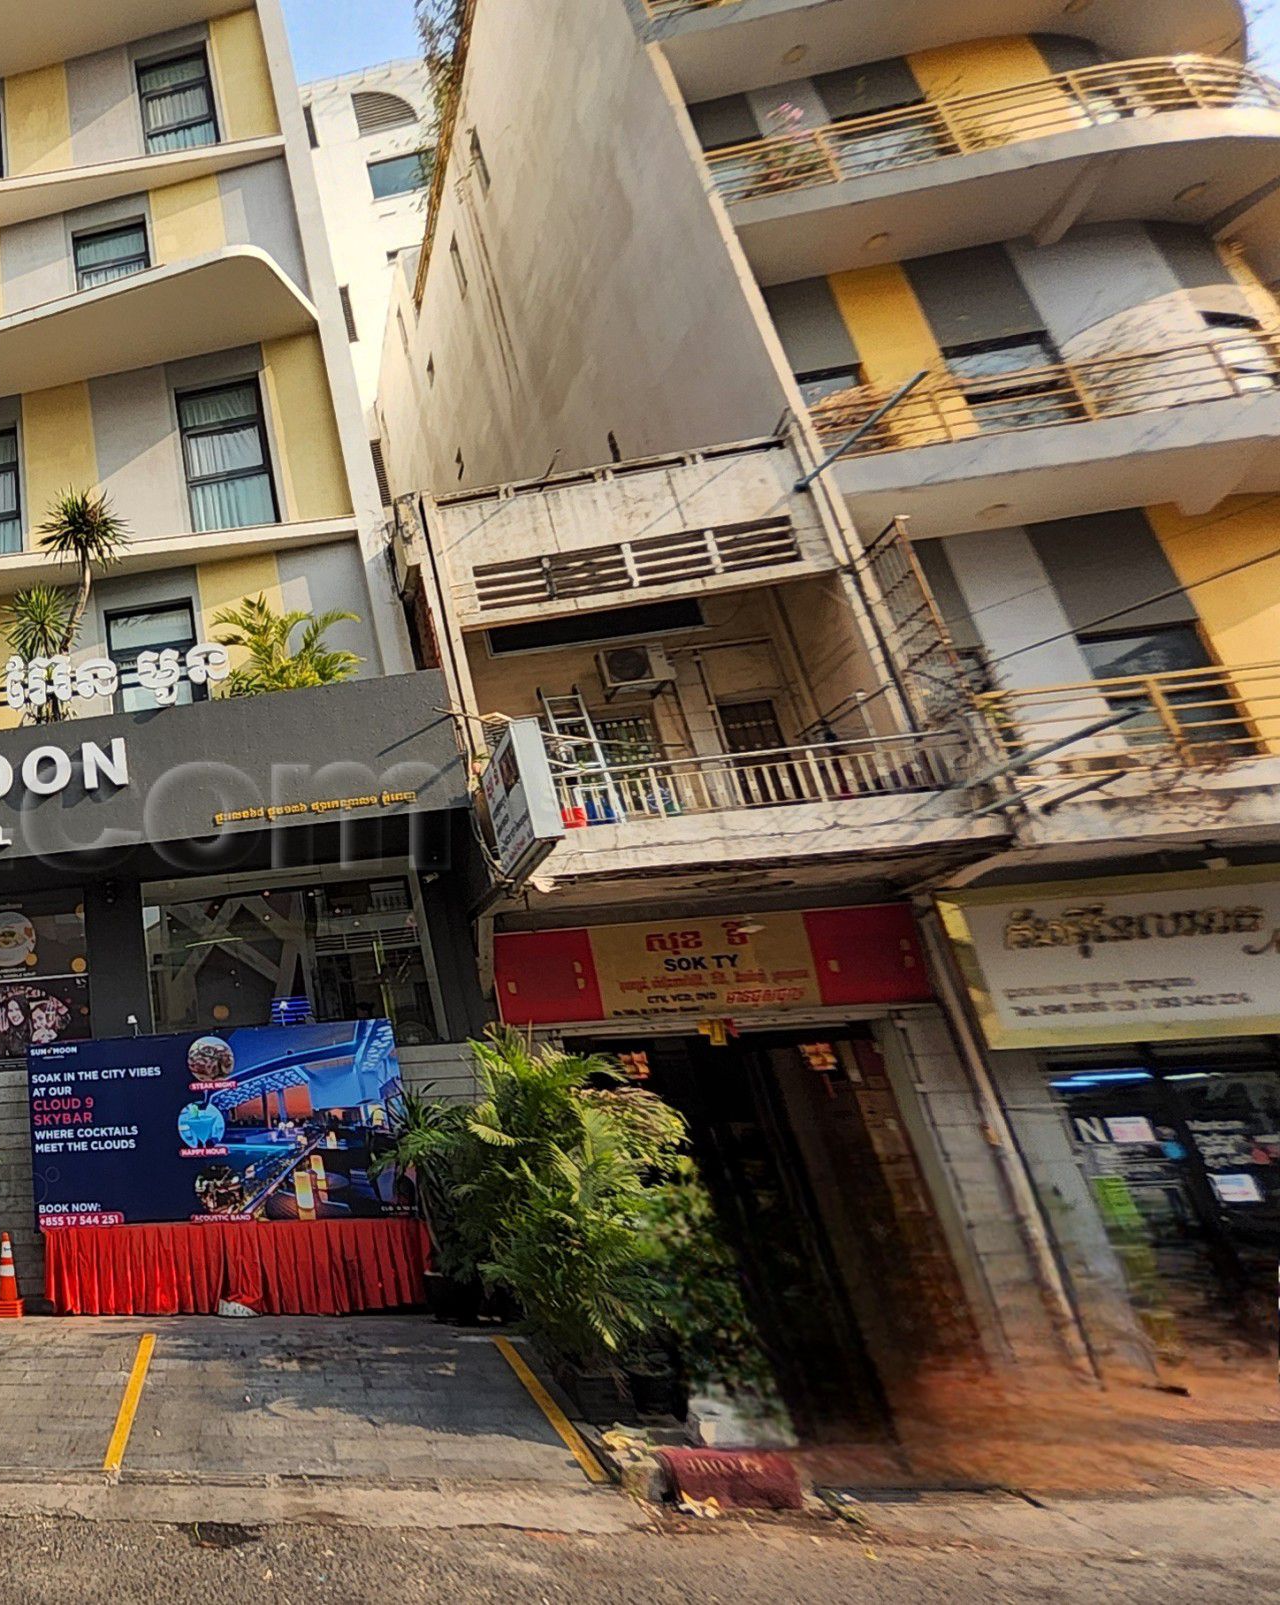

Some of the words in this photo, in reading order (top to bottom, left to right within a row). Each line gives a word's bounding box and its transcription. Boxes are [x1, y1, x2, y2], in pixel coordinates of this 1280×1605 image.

[663, 956, 708, 972] SOK
[711, 953, 739, 969] TY
[52, 1046, 78, 1055] MOON
[31, 1072, 62, 1084] SOAK
[63, 1071, 76, 1082] IN
[77, 1070, 100, 1081] THE
[101, 1068, 126, 1080] CITY
[128, 1066, 162, 1078] VIBES
[32, 1087, 46, 1098] AT
[48, 1085, 73, 1097] OUR
[33, 1098, 81, 1112] CLOUD
[85, 1096, 95, 1109] 9
[33, 1111, 94, 1126] SKYBAR
[34, 1128, 75, 1141] WHERE
[76, 1125, 139, 1138] COCKTAILS
[35, 1142, 65, 1154] MEET
[66, 1140, 89, 1152] THE
[90, 1138, 136, 1151] CLOUDS
[38, 1203, 70, 1214] BOOK
[71, 1202, 102, 1212] NOW:
[39, 1216, 65, 1227] +855
[66, 1216, 78, 1226] 17
[79, 1215, 100, 1225] 544
[101, 1214, 119, 1225] 251
[194, 1214, 229, 1223] ACOUSTIC
